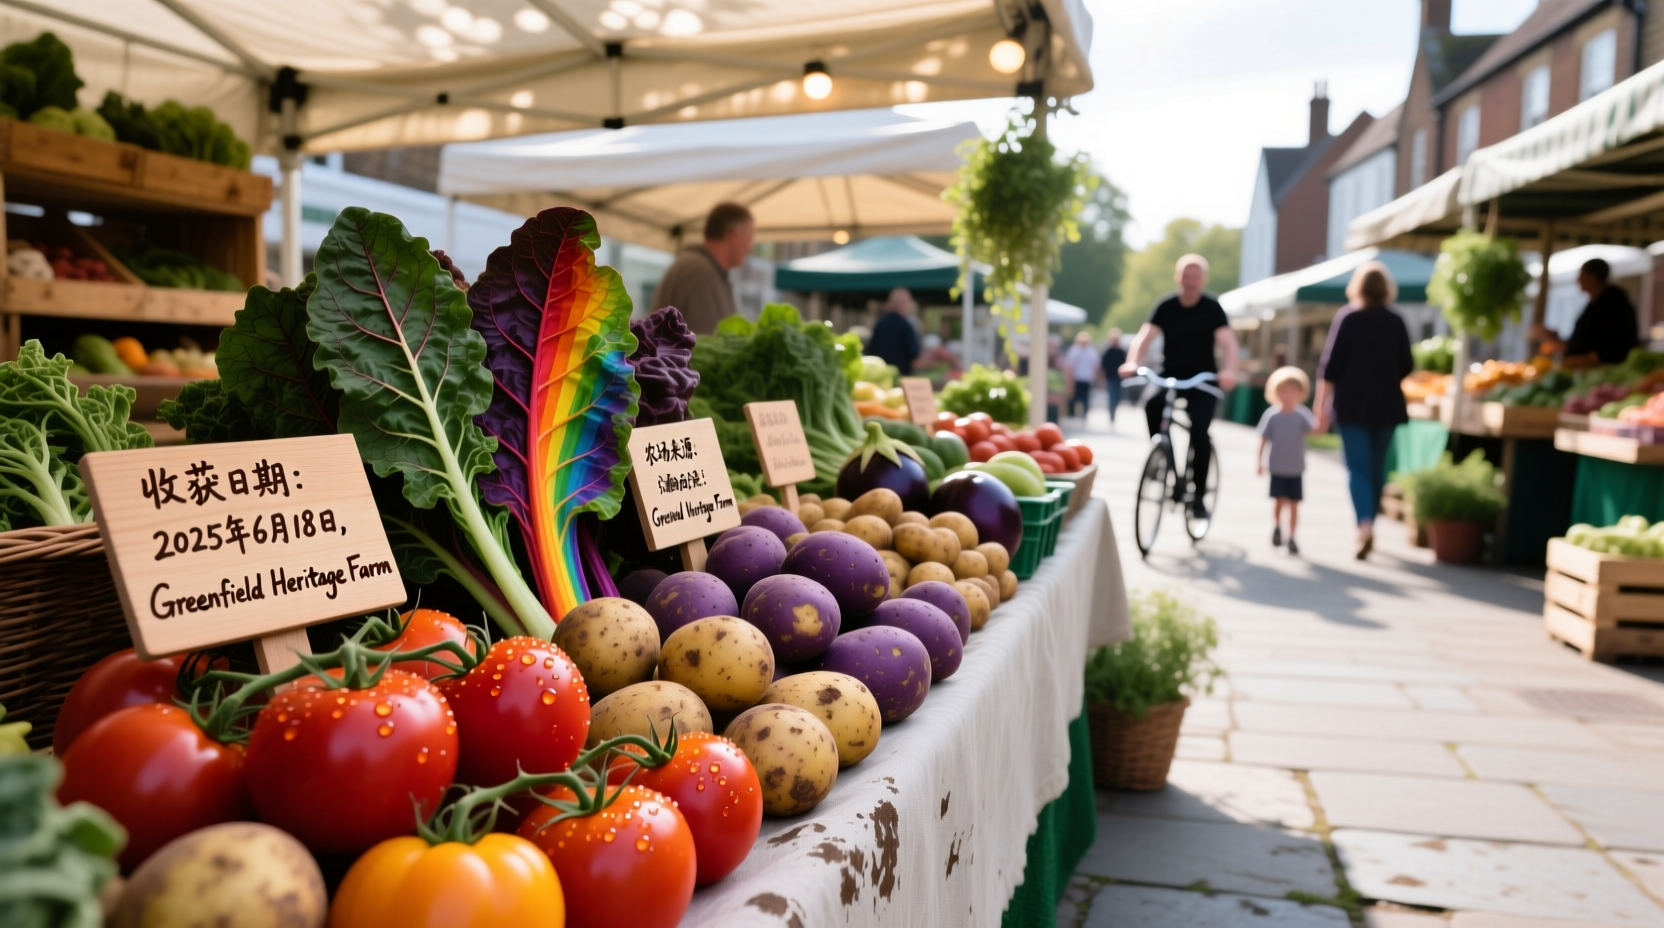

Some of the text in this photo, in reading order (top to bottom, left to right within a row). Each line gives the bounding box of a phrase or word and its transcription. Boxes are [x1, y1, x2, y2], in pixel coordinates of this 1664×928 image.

[141, 458, 303, 509] 收获日期:
[152, 509, 347, 561] 2025年6月18日,
[150, 554, 392, 619] Greenfield Heritage Farm
